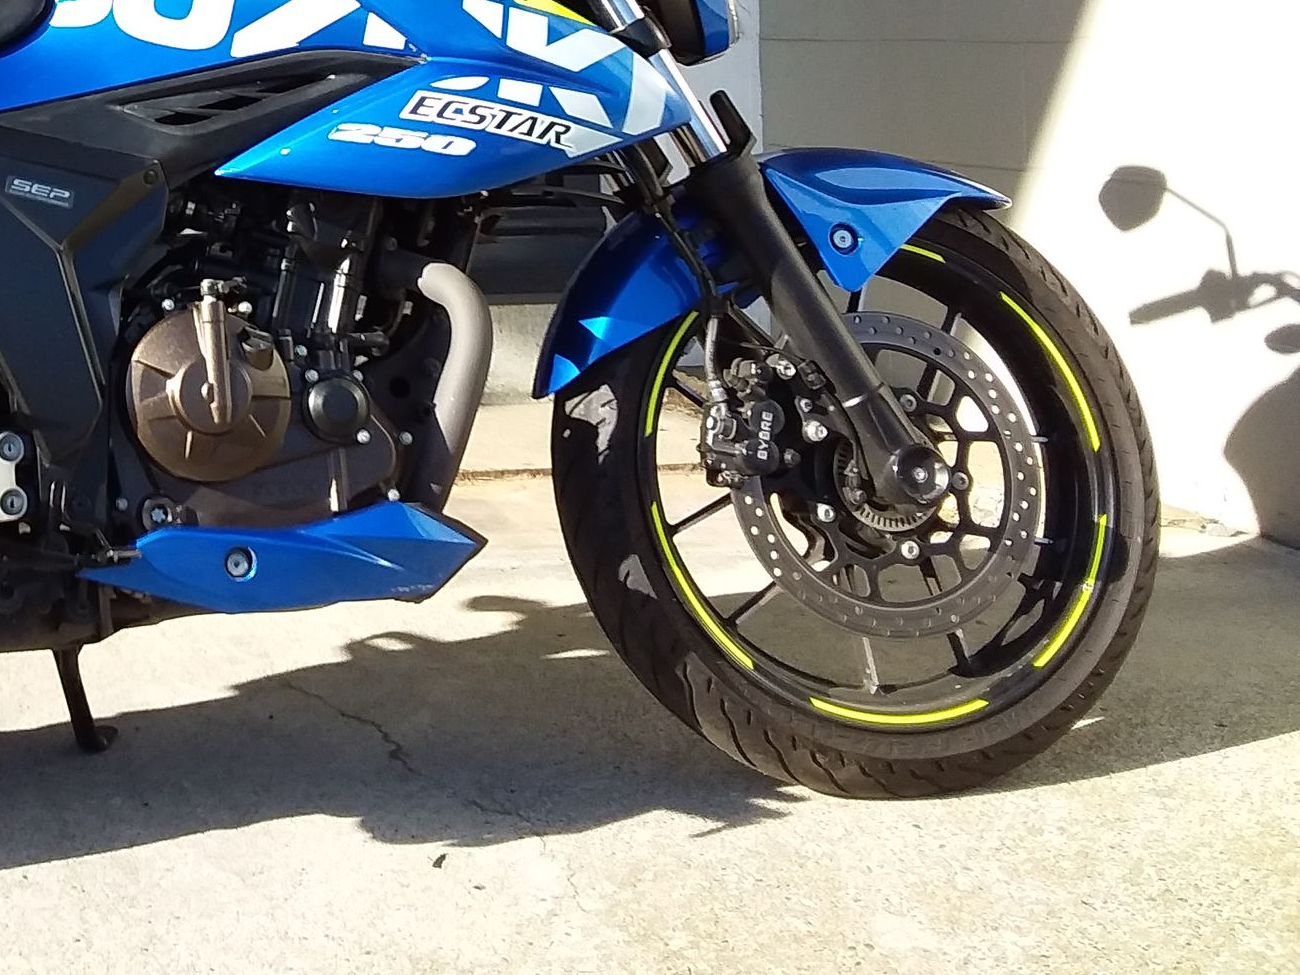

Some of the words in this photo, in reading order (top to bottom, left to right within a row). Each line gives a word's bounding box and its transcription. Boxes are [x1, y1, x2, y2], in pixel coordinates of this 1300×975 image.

[409, 97, 573, 148] ECSTAR
[328, 123, 477, 156] 250
[11, 178, 70, 198] SEP
